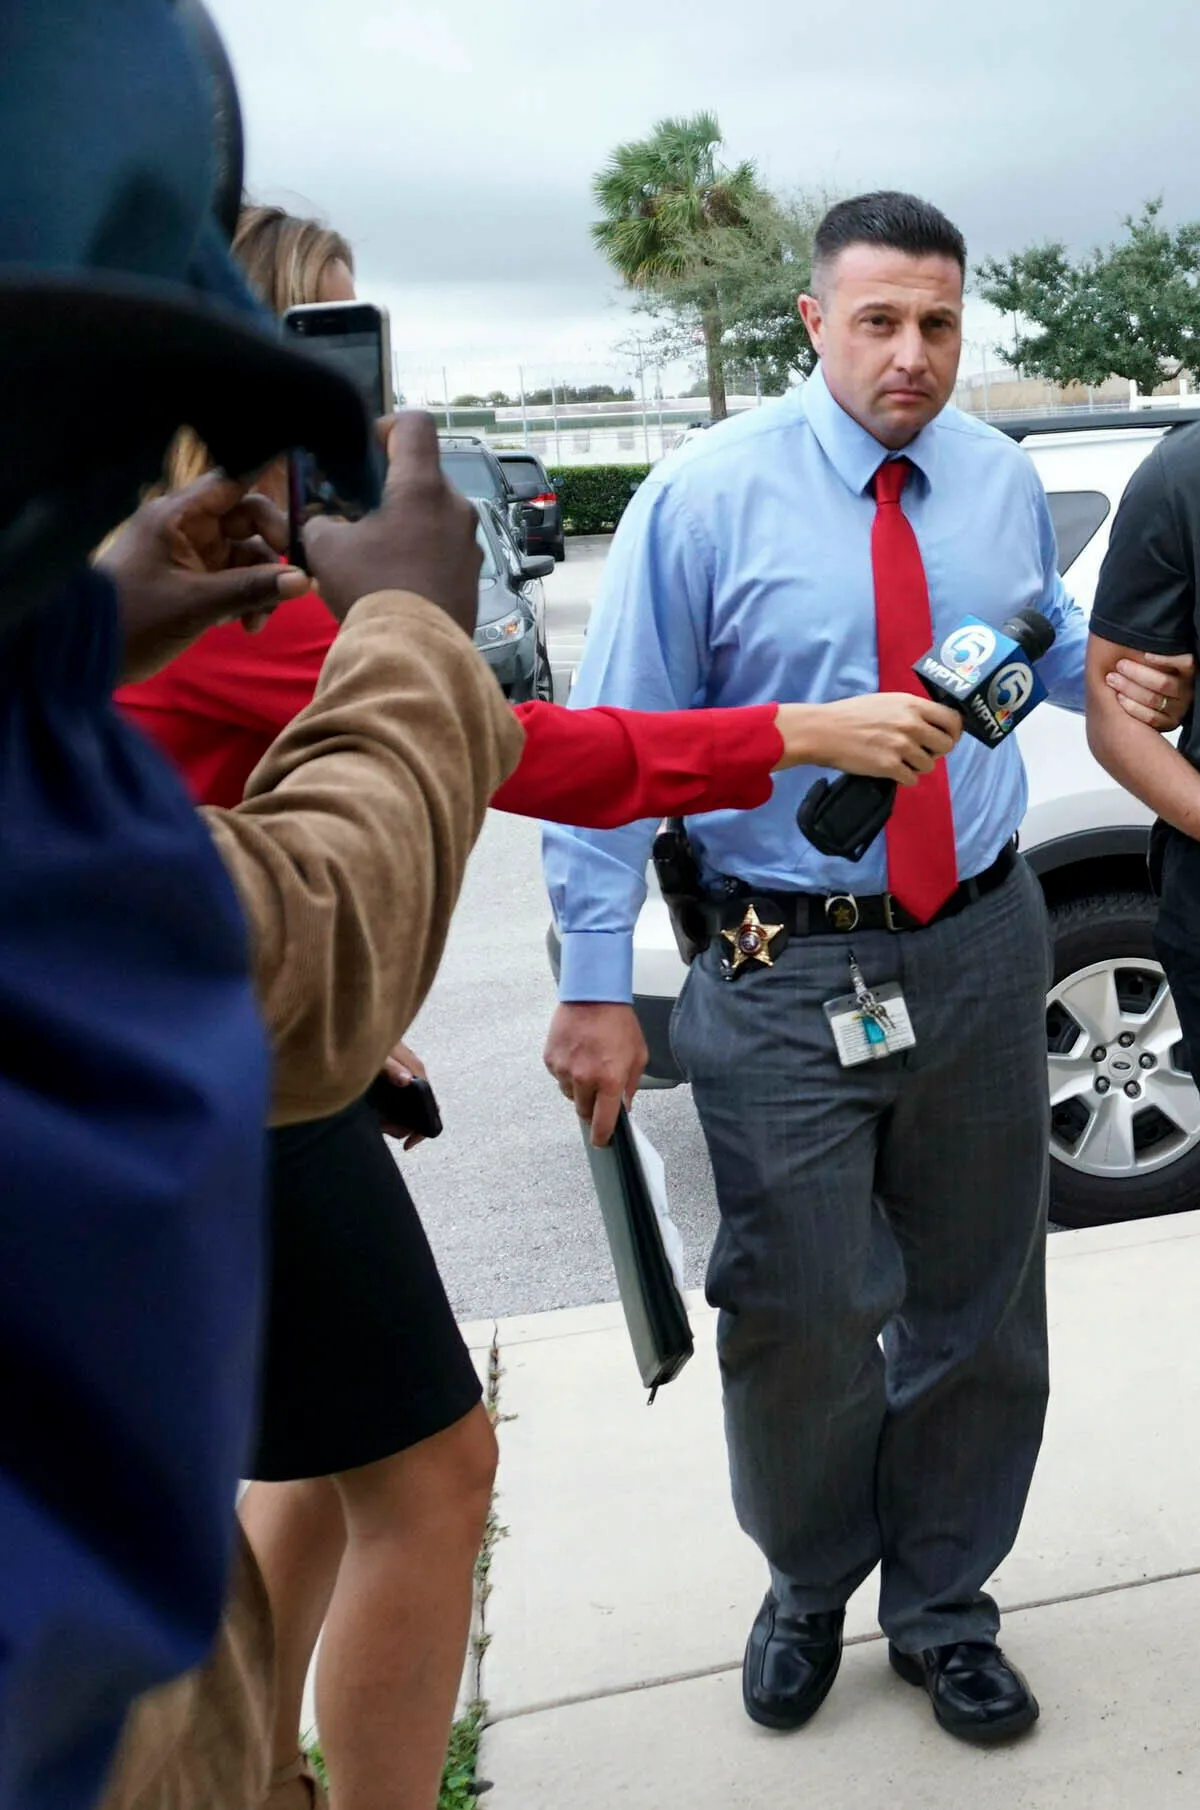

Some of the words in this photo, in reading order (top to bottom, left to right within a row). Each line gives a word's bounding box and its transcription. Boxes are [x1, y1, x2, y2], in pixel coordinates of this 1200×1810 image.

[921, 657, 974, 693] WPTV
[992, 664, 1030, 711] 5
[970, 693, 1005, 741] WPTV
